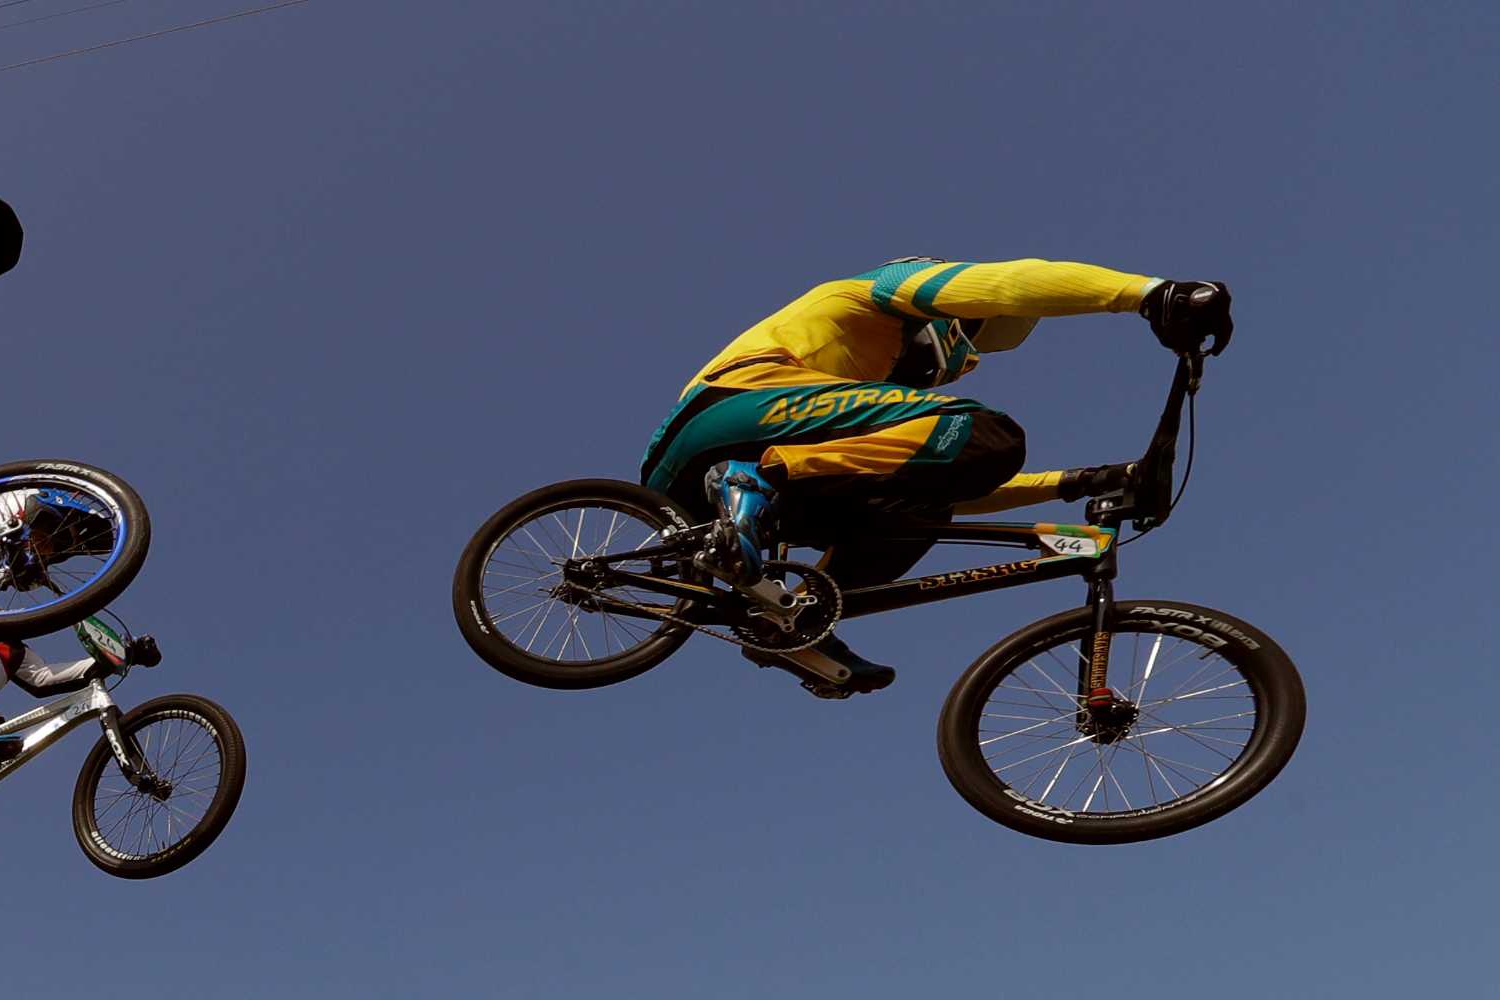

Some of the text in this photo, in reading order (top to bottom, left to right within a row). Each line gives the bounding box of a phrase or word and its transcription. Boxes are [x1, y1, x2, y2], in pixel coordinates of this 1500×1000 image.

[1053, 538, 1083, 553] 44
[1130, 606, 1213, 626] FASTR X
[1003, 788, 1077, 818] BOX
